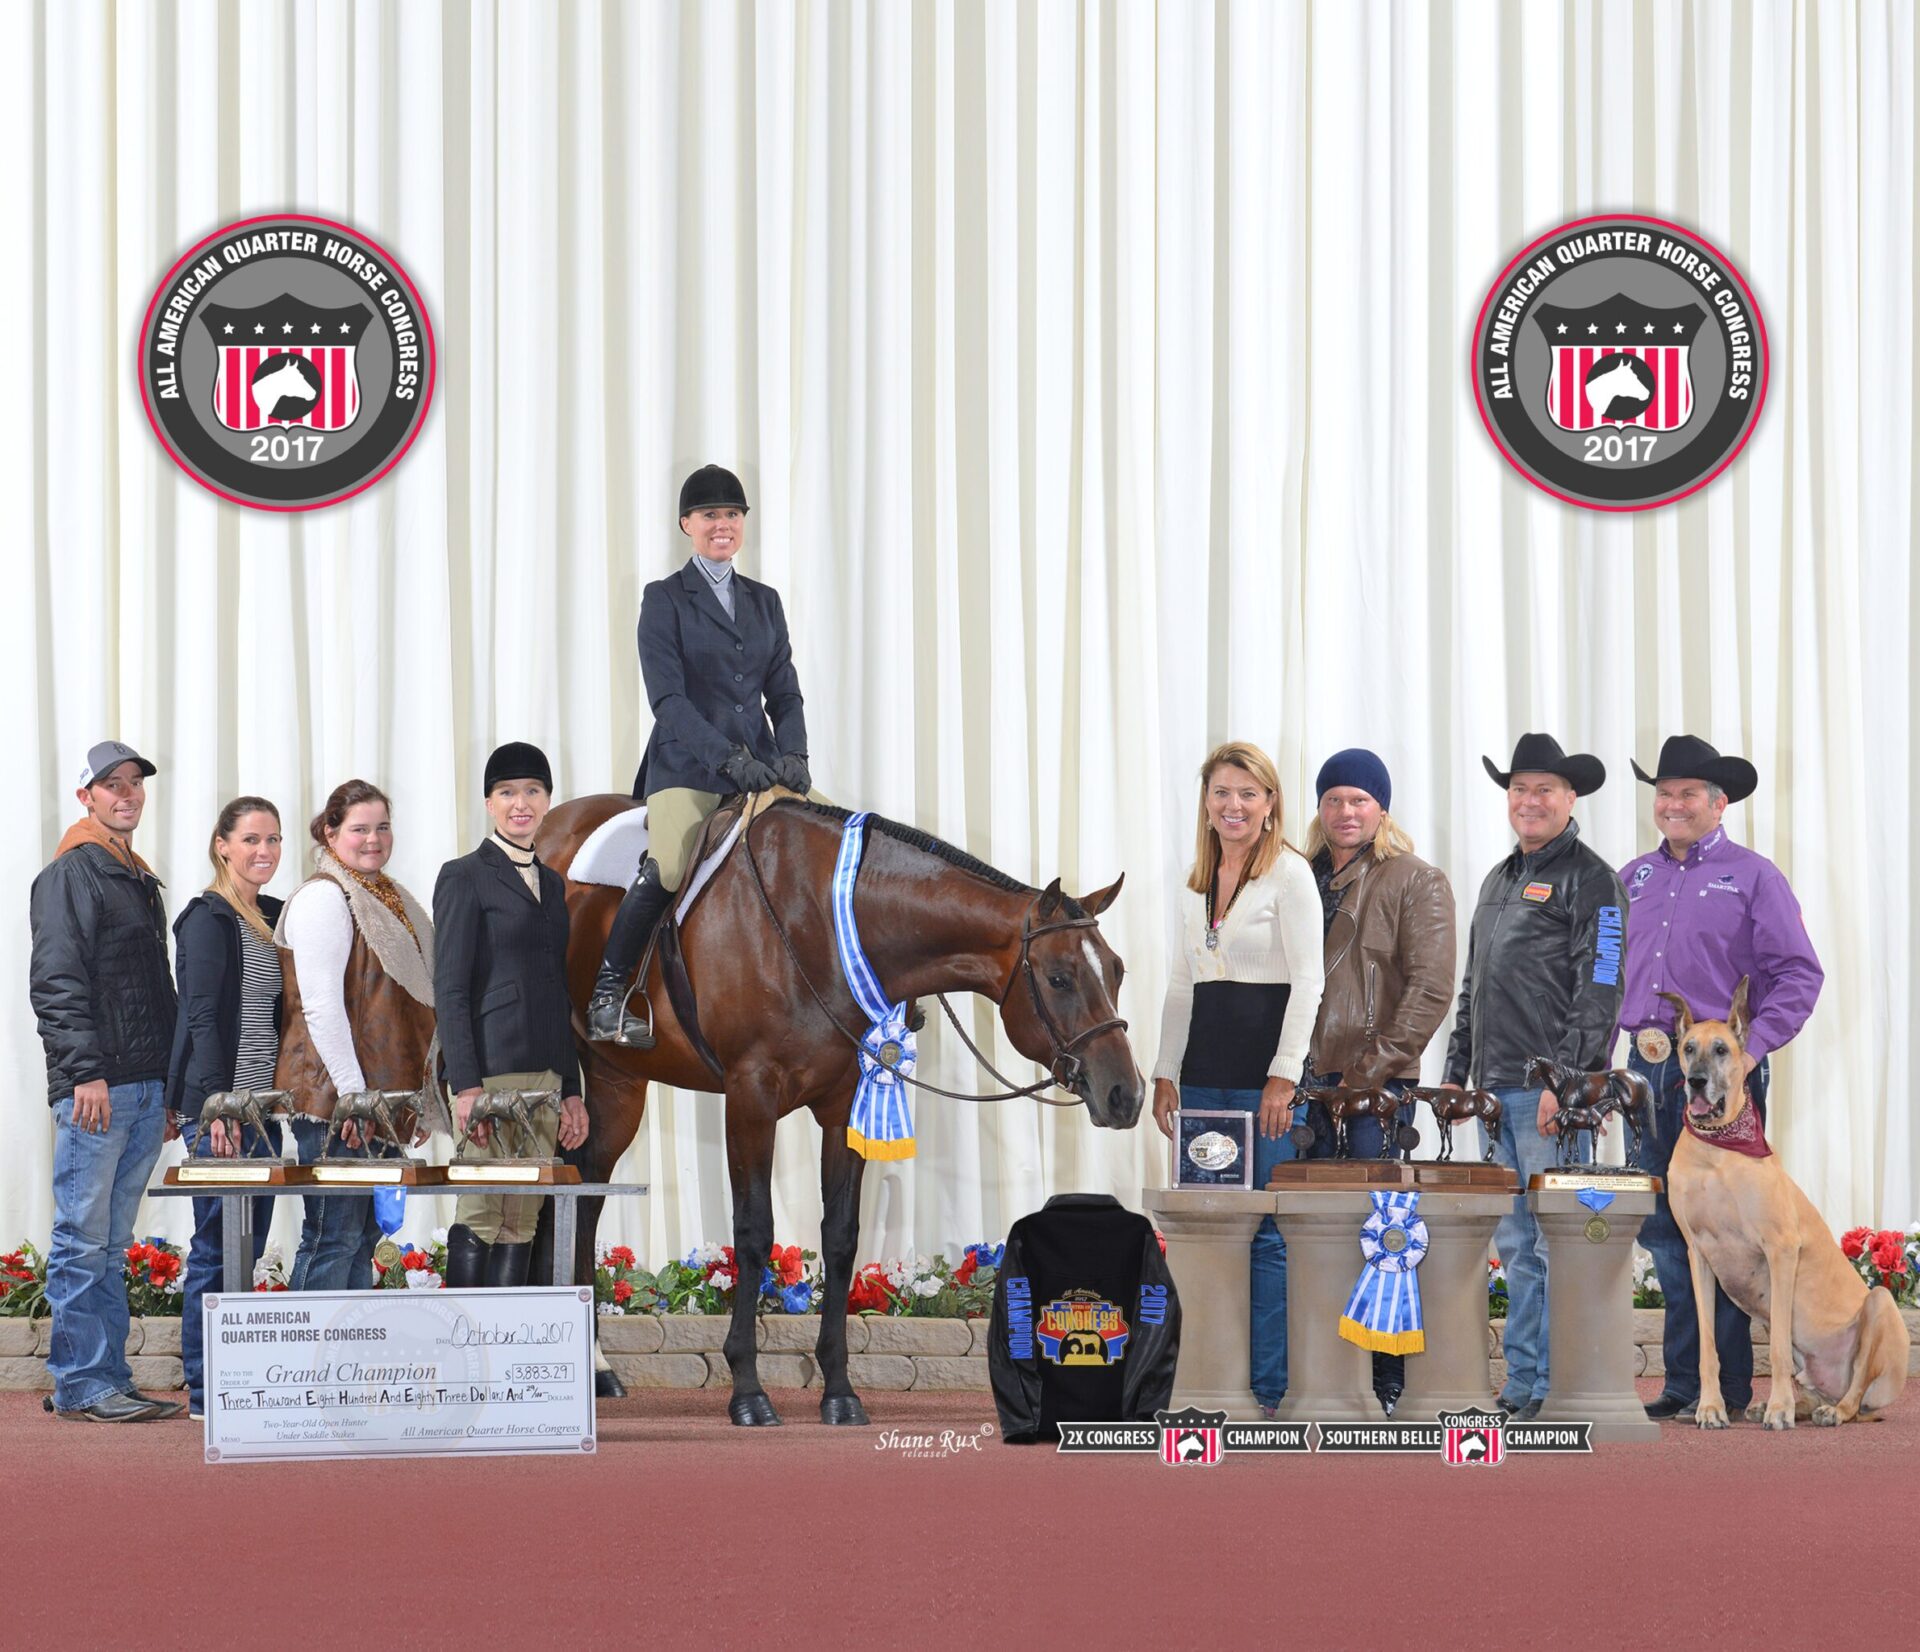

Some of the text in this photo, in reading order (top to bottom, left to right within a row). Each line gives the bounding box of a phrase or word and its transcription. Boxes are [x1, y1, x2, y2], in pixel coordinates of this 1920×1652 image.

[1592, 906, 1622, 986] CHAMPION
[1140, 1284, 1168, 1325] 2017
[221, 1311, 311, 1325] ALL AMERICAN
[1006, 1276, 1033, 1360] CHAMPION
[1047, 1311, 1119, 1331] CONGRESS
[221, 1328, 387, 1345] QUARTER HORSE CONGRESS
[266, 1362, 437, 1385] Grand Champion
[217, 1391, 253, 1410] Three
[305, 1390, 335, 1409] Eight
[339, 1390, 377, 1406] Hundred
[380, 1389, 401, 1404] And
[404, 1387, 435, 1409] Eighty
[436, 1389, 468, 1402] Three
[506, 1388, 524, 1401] And
[263, 1418, 368, 1429] Two-Year-Old Open Hunter
[401, 1424, 581, 1437] All American Quarter Horse Congress
[276, 1431, 301, 1440] Under
[303, 1431, 330, 1439] Saddle
